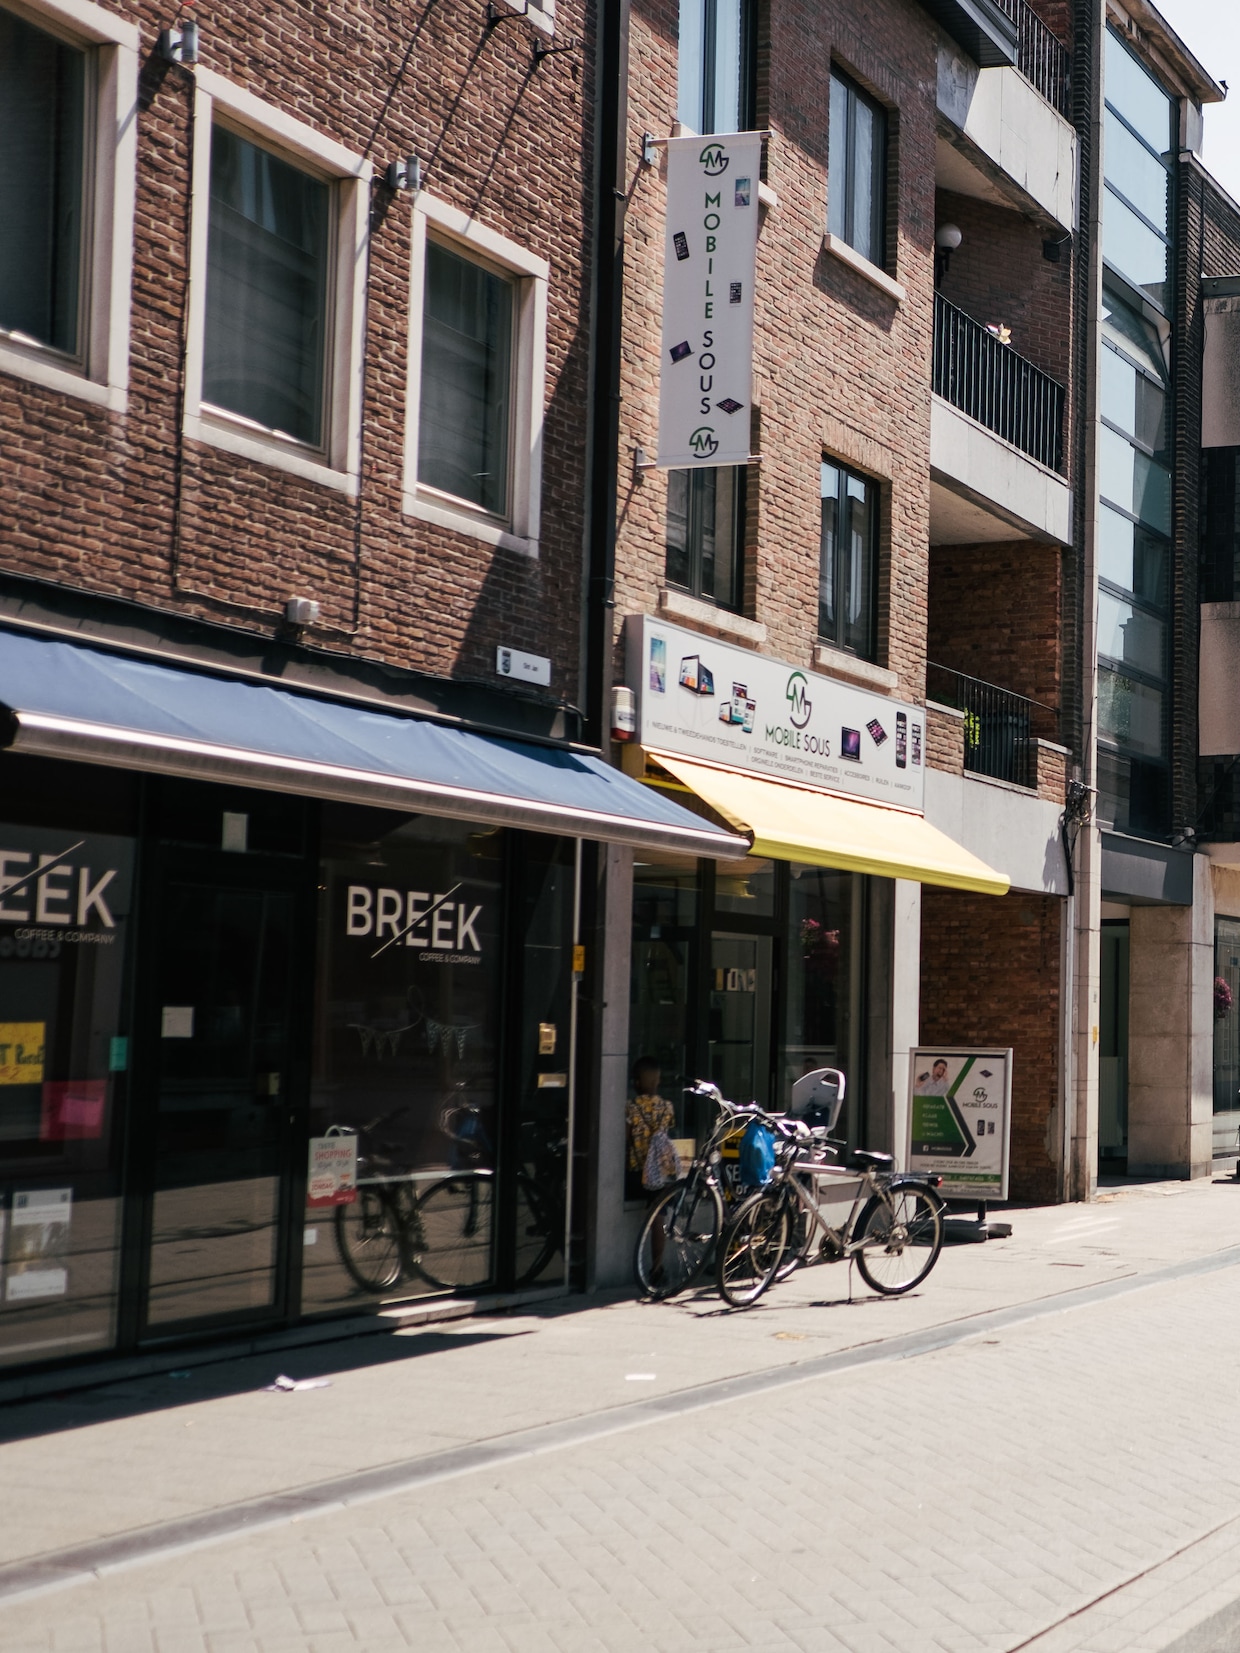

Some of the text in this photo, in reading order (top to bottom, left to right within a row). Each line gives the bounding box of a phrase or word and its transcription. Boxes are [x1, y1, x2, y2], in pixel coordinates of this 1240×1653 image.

[704, 191, 721, 320] MOBILE
[698, 330, 716, 415] SOUS
[765, 723, 831, 758] MOBILE SOUS
[346, 885, 483, 952] BREEK
[14, 928, 54, 942] COFFEE
[65, 931, 117, 945] COMPANY
[419, 952, 444, 962] COFFEE
[449, 954, 482, 965] COMPANY
[314, 1149, 352, 1161] SHOPPING
